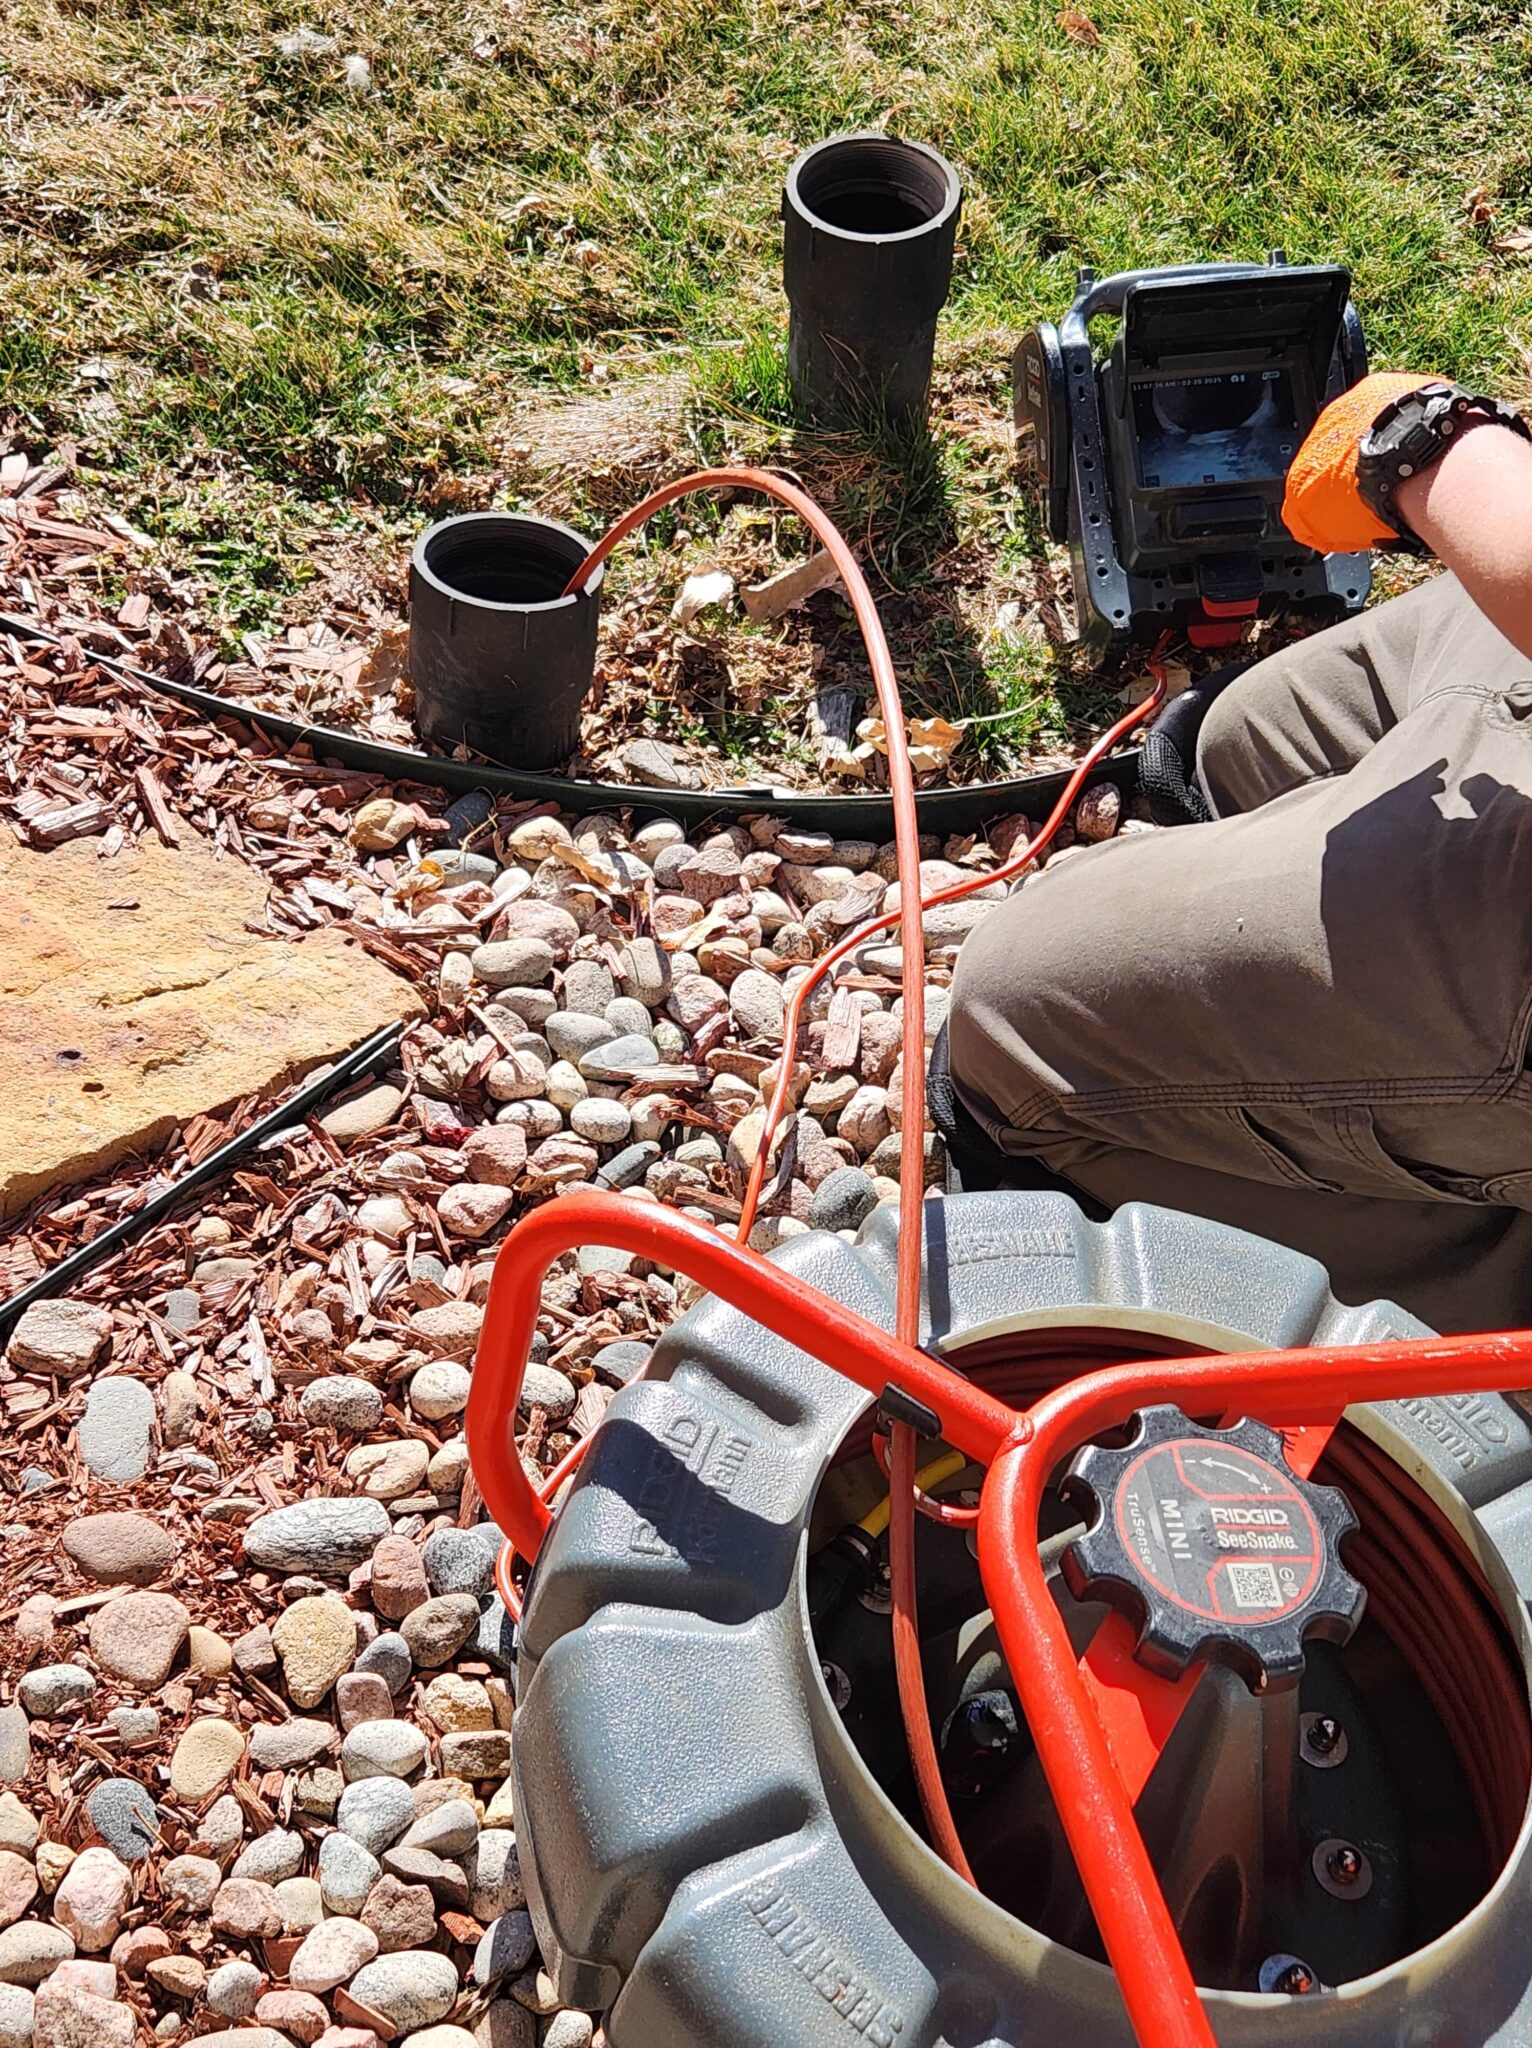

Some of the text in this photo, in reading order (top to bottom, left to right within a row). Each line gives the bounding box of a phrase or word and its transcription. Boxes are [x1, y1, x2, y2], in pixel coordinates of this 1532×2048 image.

[1210, 1507, 1289, 1525] RIDGID
[1160, 1499, 1192, 1559] MINI
[1216, 1530, 1298, 1549] SeeSnake
